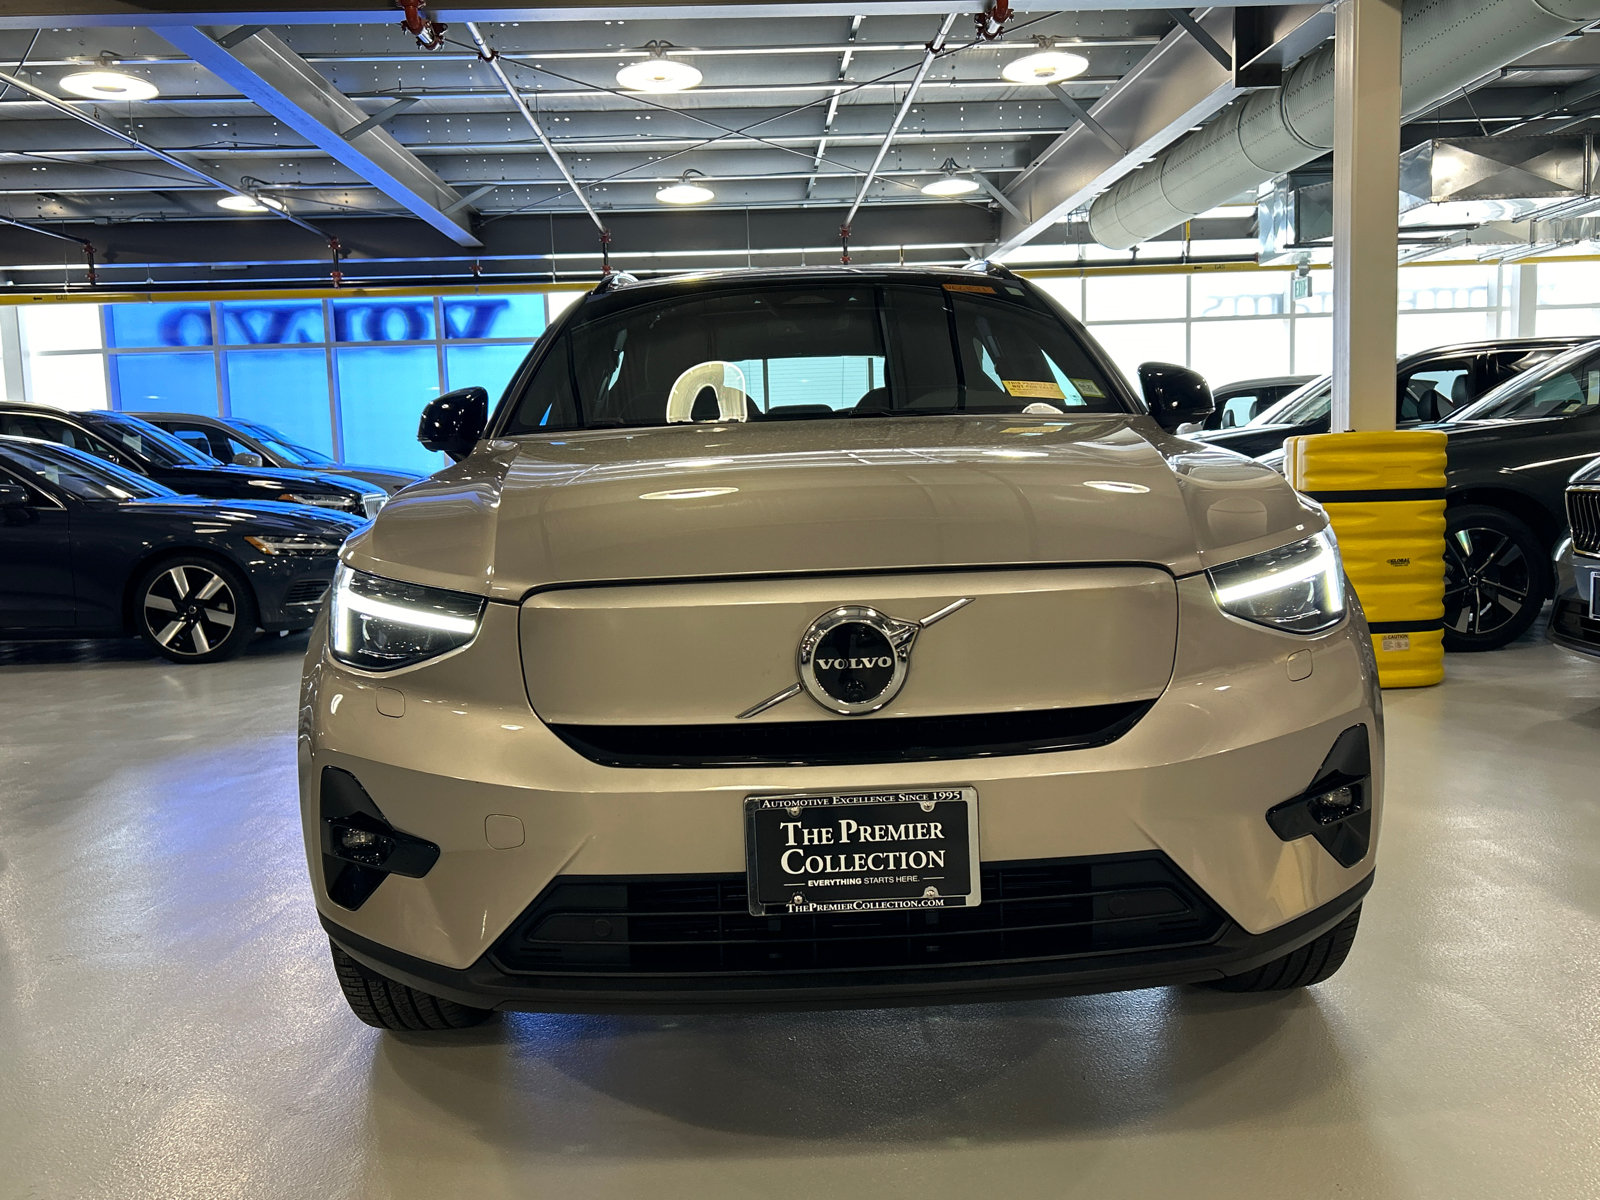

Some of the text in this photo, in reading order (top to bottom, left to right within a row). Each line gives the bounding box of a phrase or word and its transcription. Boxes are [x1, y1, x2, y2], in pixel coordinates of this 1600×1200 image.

[816, 656, 892, 670] VOLVO
[761, 791, 960, 808] AUTOMOTIVE EXCELLENCE SINCE 1995
[780, 819, 945, 846] THE PREMIER
[780, 849, 946, 875] COLLECTION
[807, 875, 920, 887] EVERYTHING STARTS HERE.
